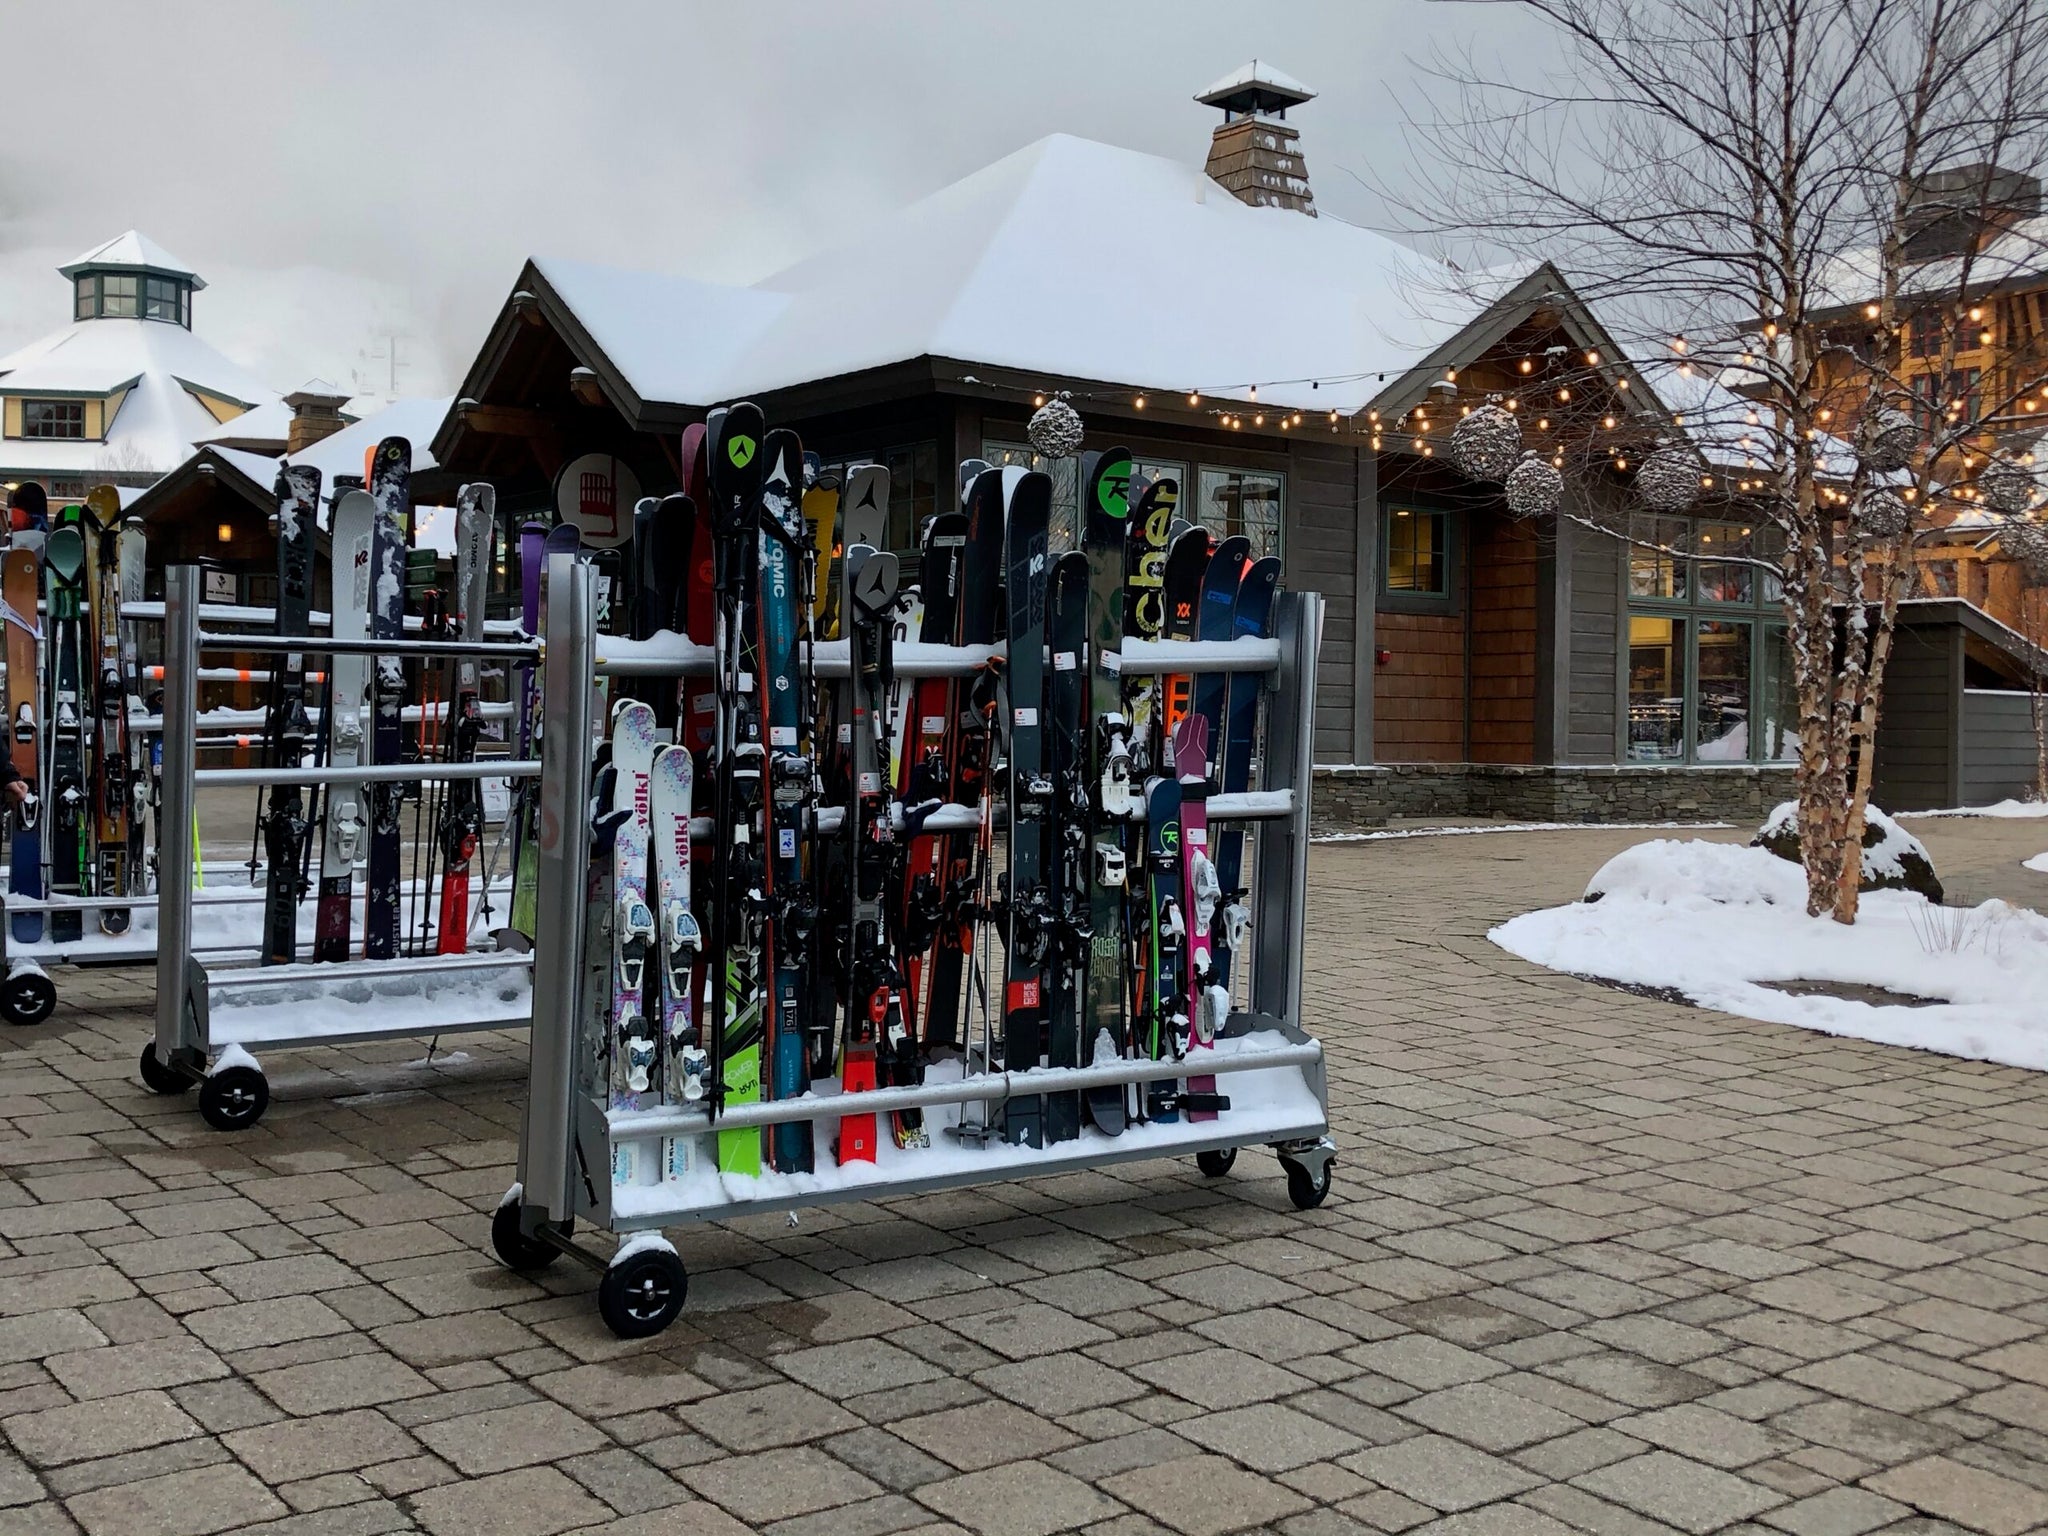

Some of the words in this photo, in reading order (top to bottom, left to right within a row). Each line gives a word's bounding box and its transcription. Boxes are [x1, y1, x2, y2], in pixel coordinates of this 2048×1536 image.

[354, 550, 368, 568] K2
[470, 531, 479, 568] ATOMIC
[772, 538, 785, 598] TOMIC
[1030, 553, 1044, 577] K2
[1128, 485, 1179, 641] cher
[635, 773, 649, 826] völkl
[674, 815, 689, 867] völkl
[392, 906, 400, 954] RUSTLER
